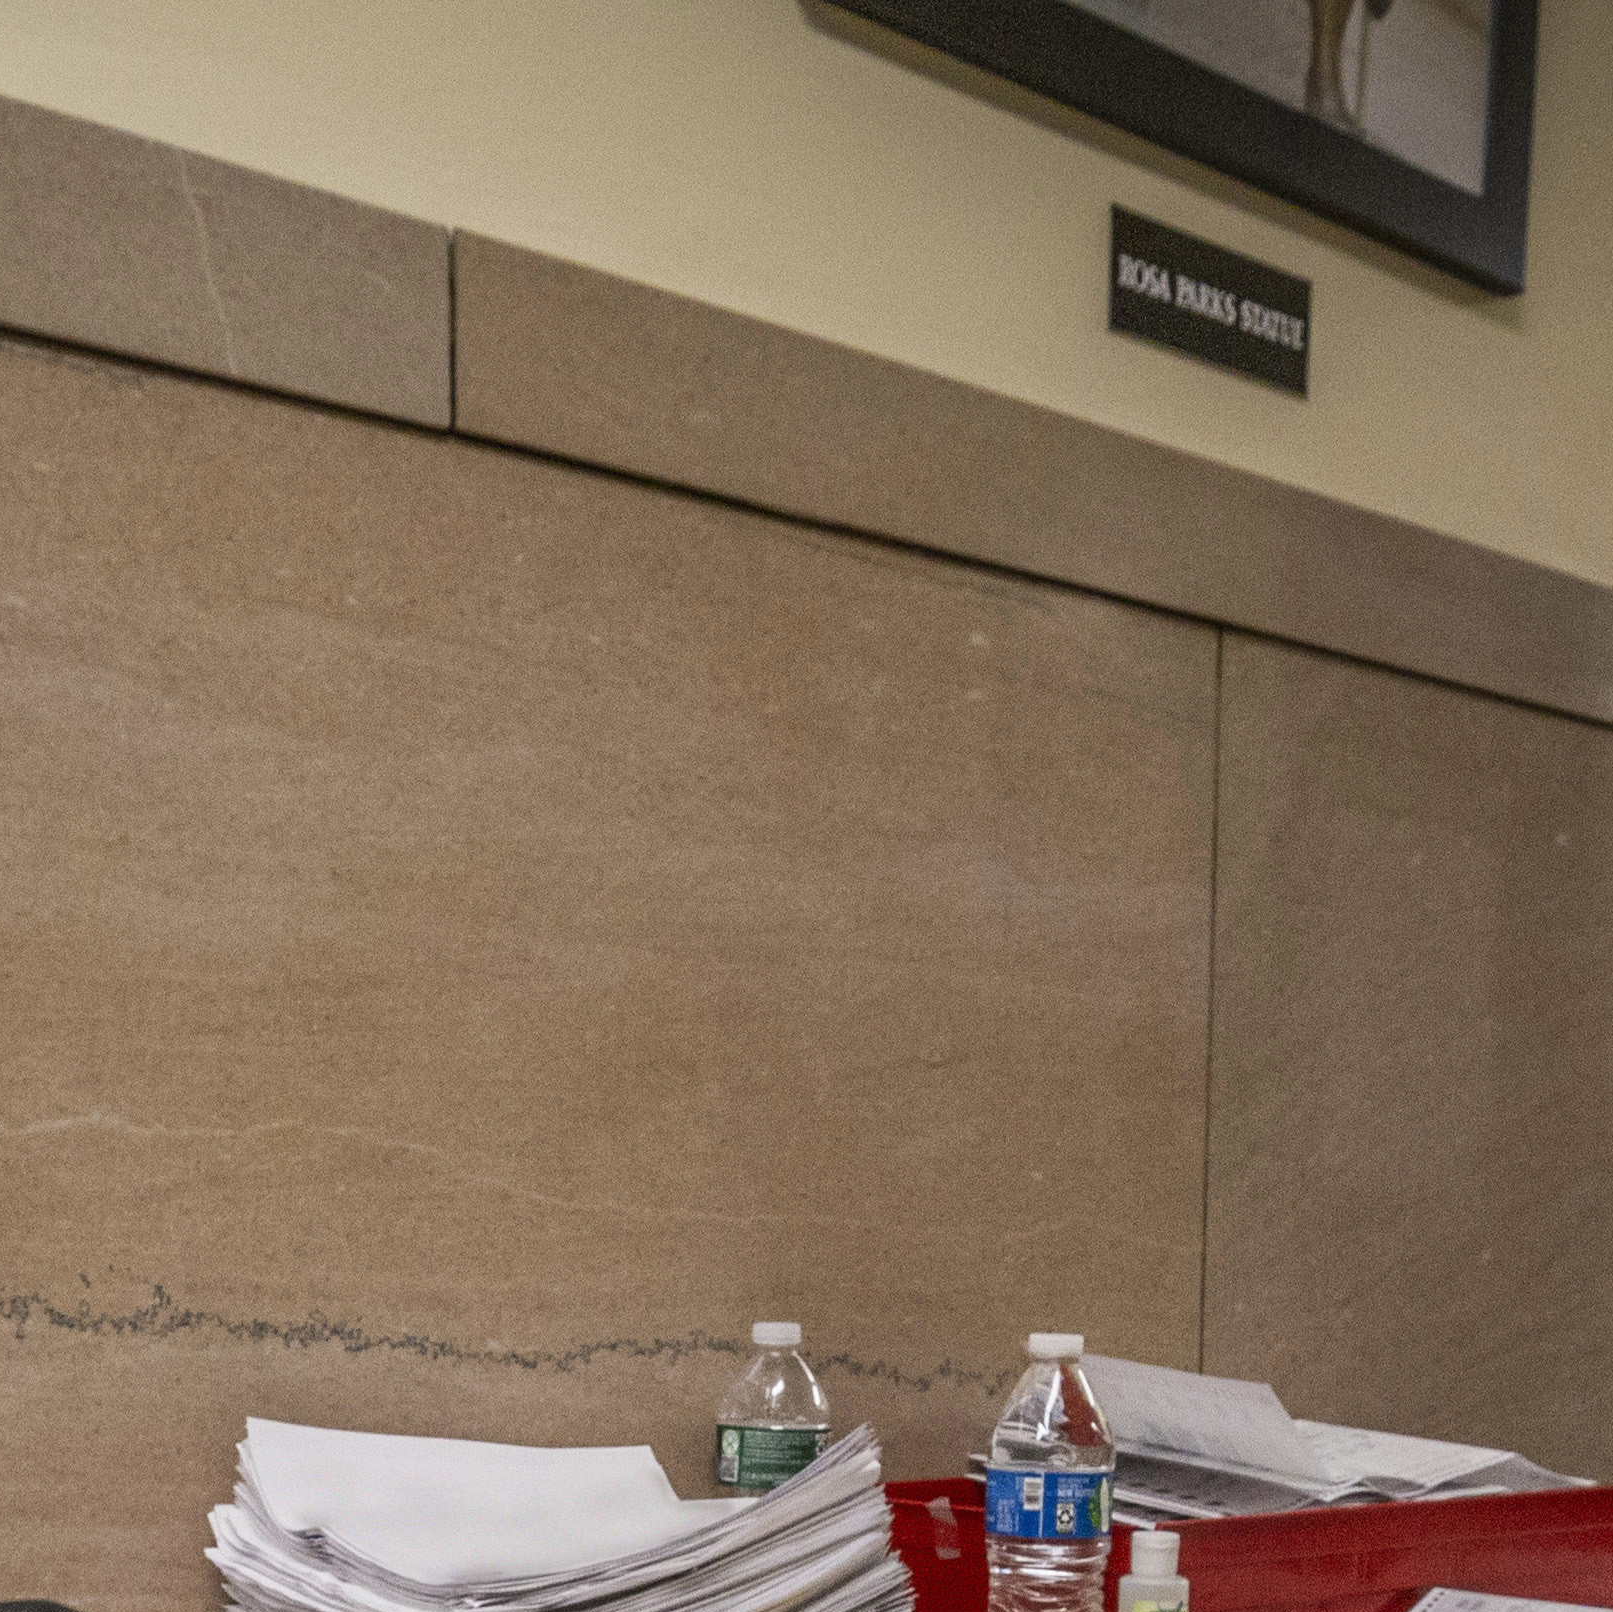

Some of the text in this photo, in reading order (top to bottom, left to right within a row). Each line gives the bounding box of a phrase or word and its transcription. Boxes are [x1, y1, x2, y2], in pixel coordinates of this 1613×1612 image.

[1118, 253, 1304, 350] ROSA PARKS STATUE
